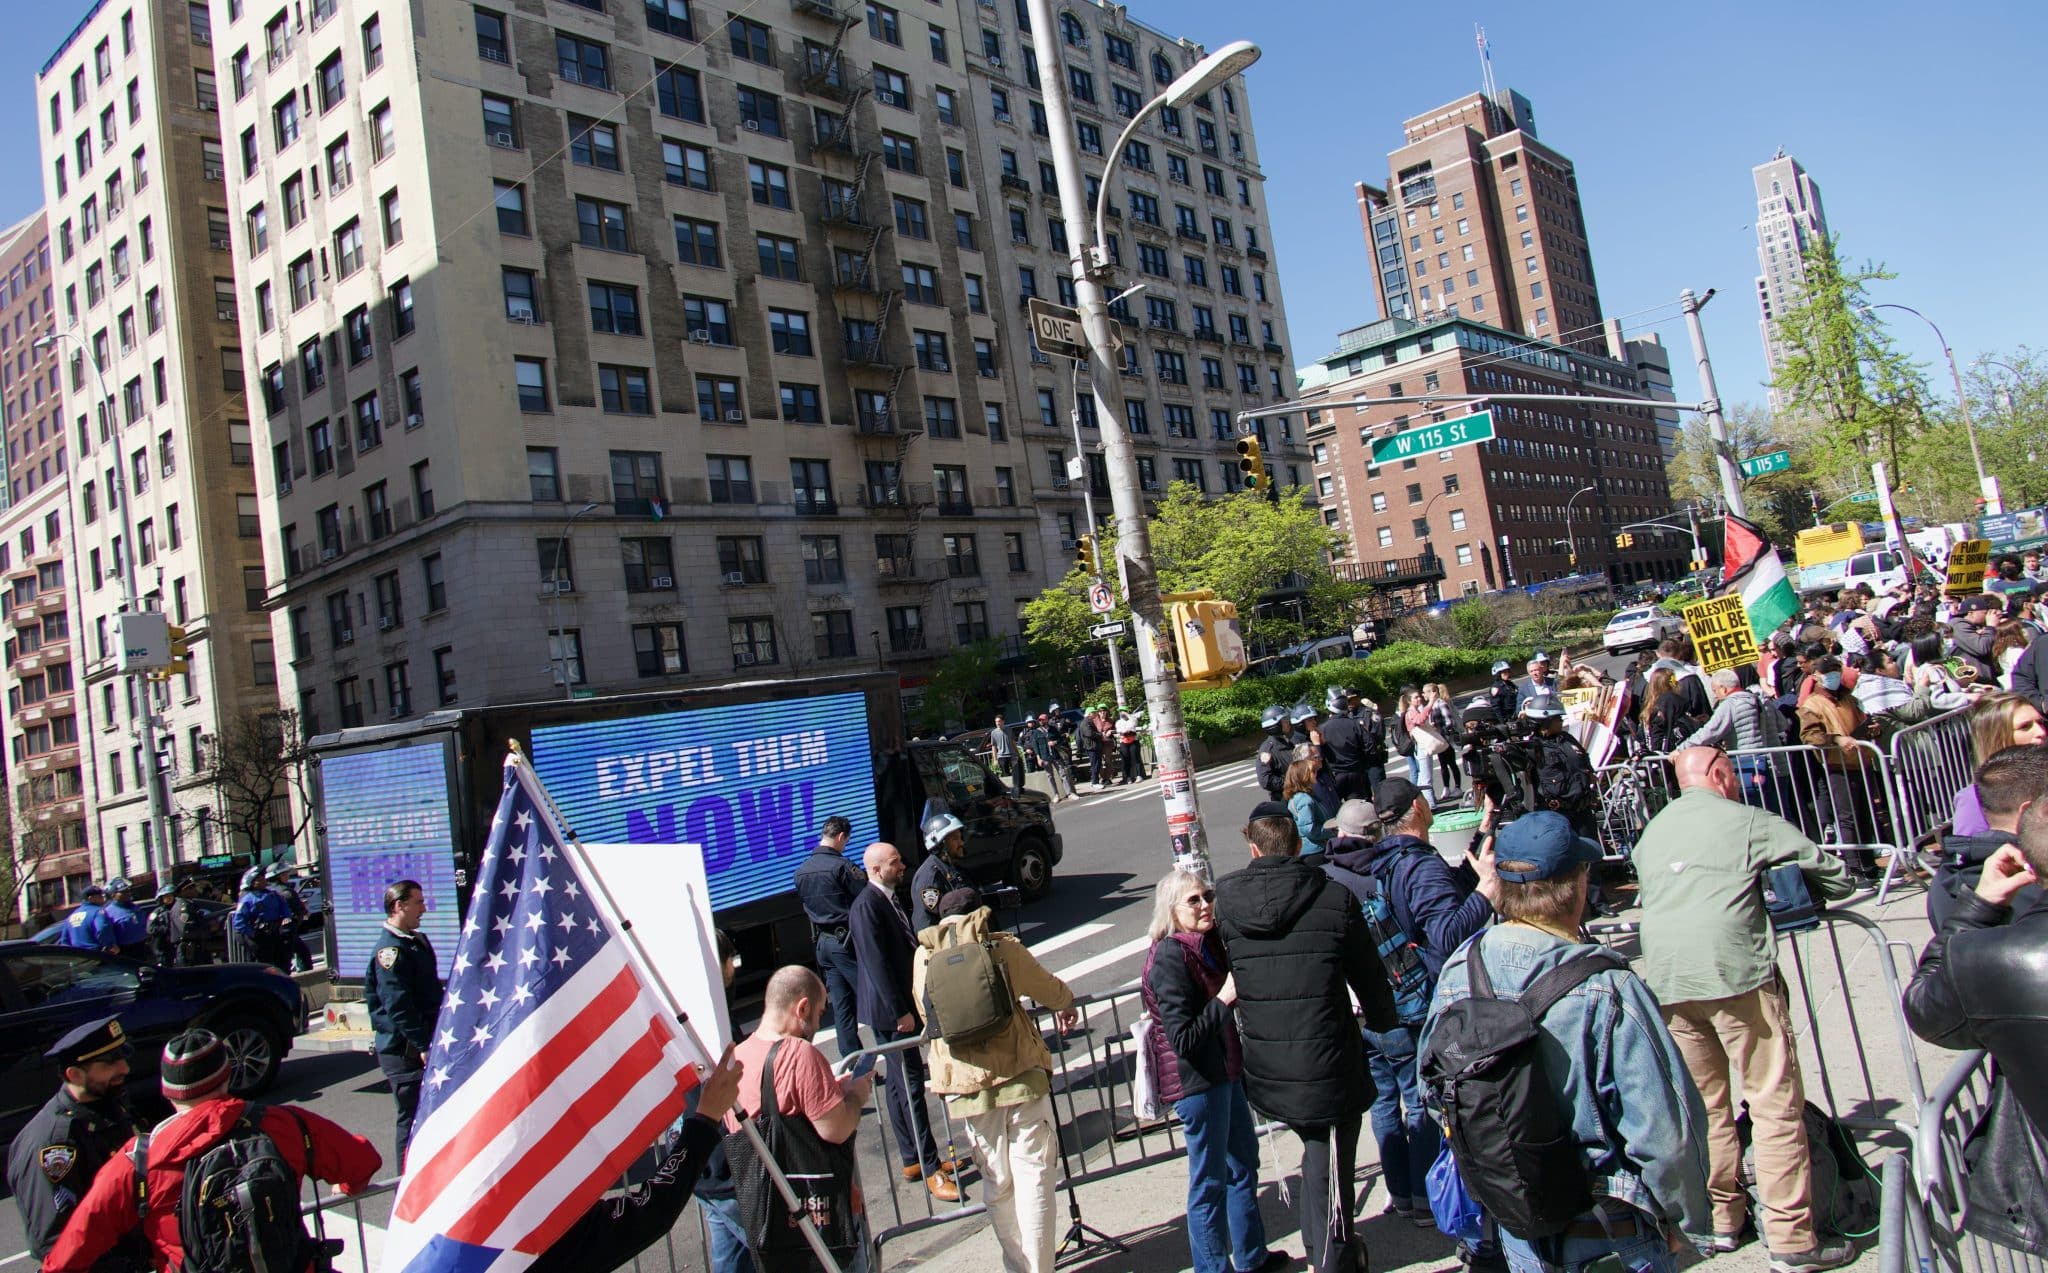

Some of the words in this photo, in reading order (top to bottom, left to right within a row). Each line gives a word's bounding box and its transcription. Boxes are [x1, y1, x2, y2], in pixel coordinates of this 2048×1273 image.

[1042, 318, 1073, 342] ONE
[1396, 436, 1411, 454] W
[1419, 429, 1443, 449] 115
[1450, 423, 1468, 441] St
[1741, 462, 1752, 476] W
[1756, 458, 1773, 473] 115
[1776, 453, 1784, 463] St
[1950, 554, 1965, 566] THE
[1947, 572, 1965, 585] NOT
[1685, 596, 1742, 622] PALESTINE
[1691, 615, 1727, 638] WILL
[1727, 610, 1748, 629] BE
[127, 648, 148, 657] NYC
[1698, 629, 1756, 666] FREE!
[596, 746, 723, 800] EXPEL
[732, 730, 828, 778] THEM
